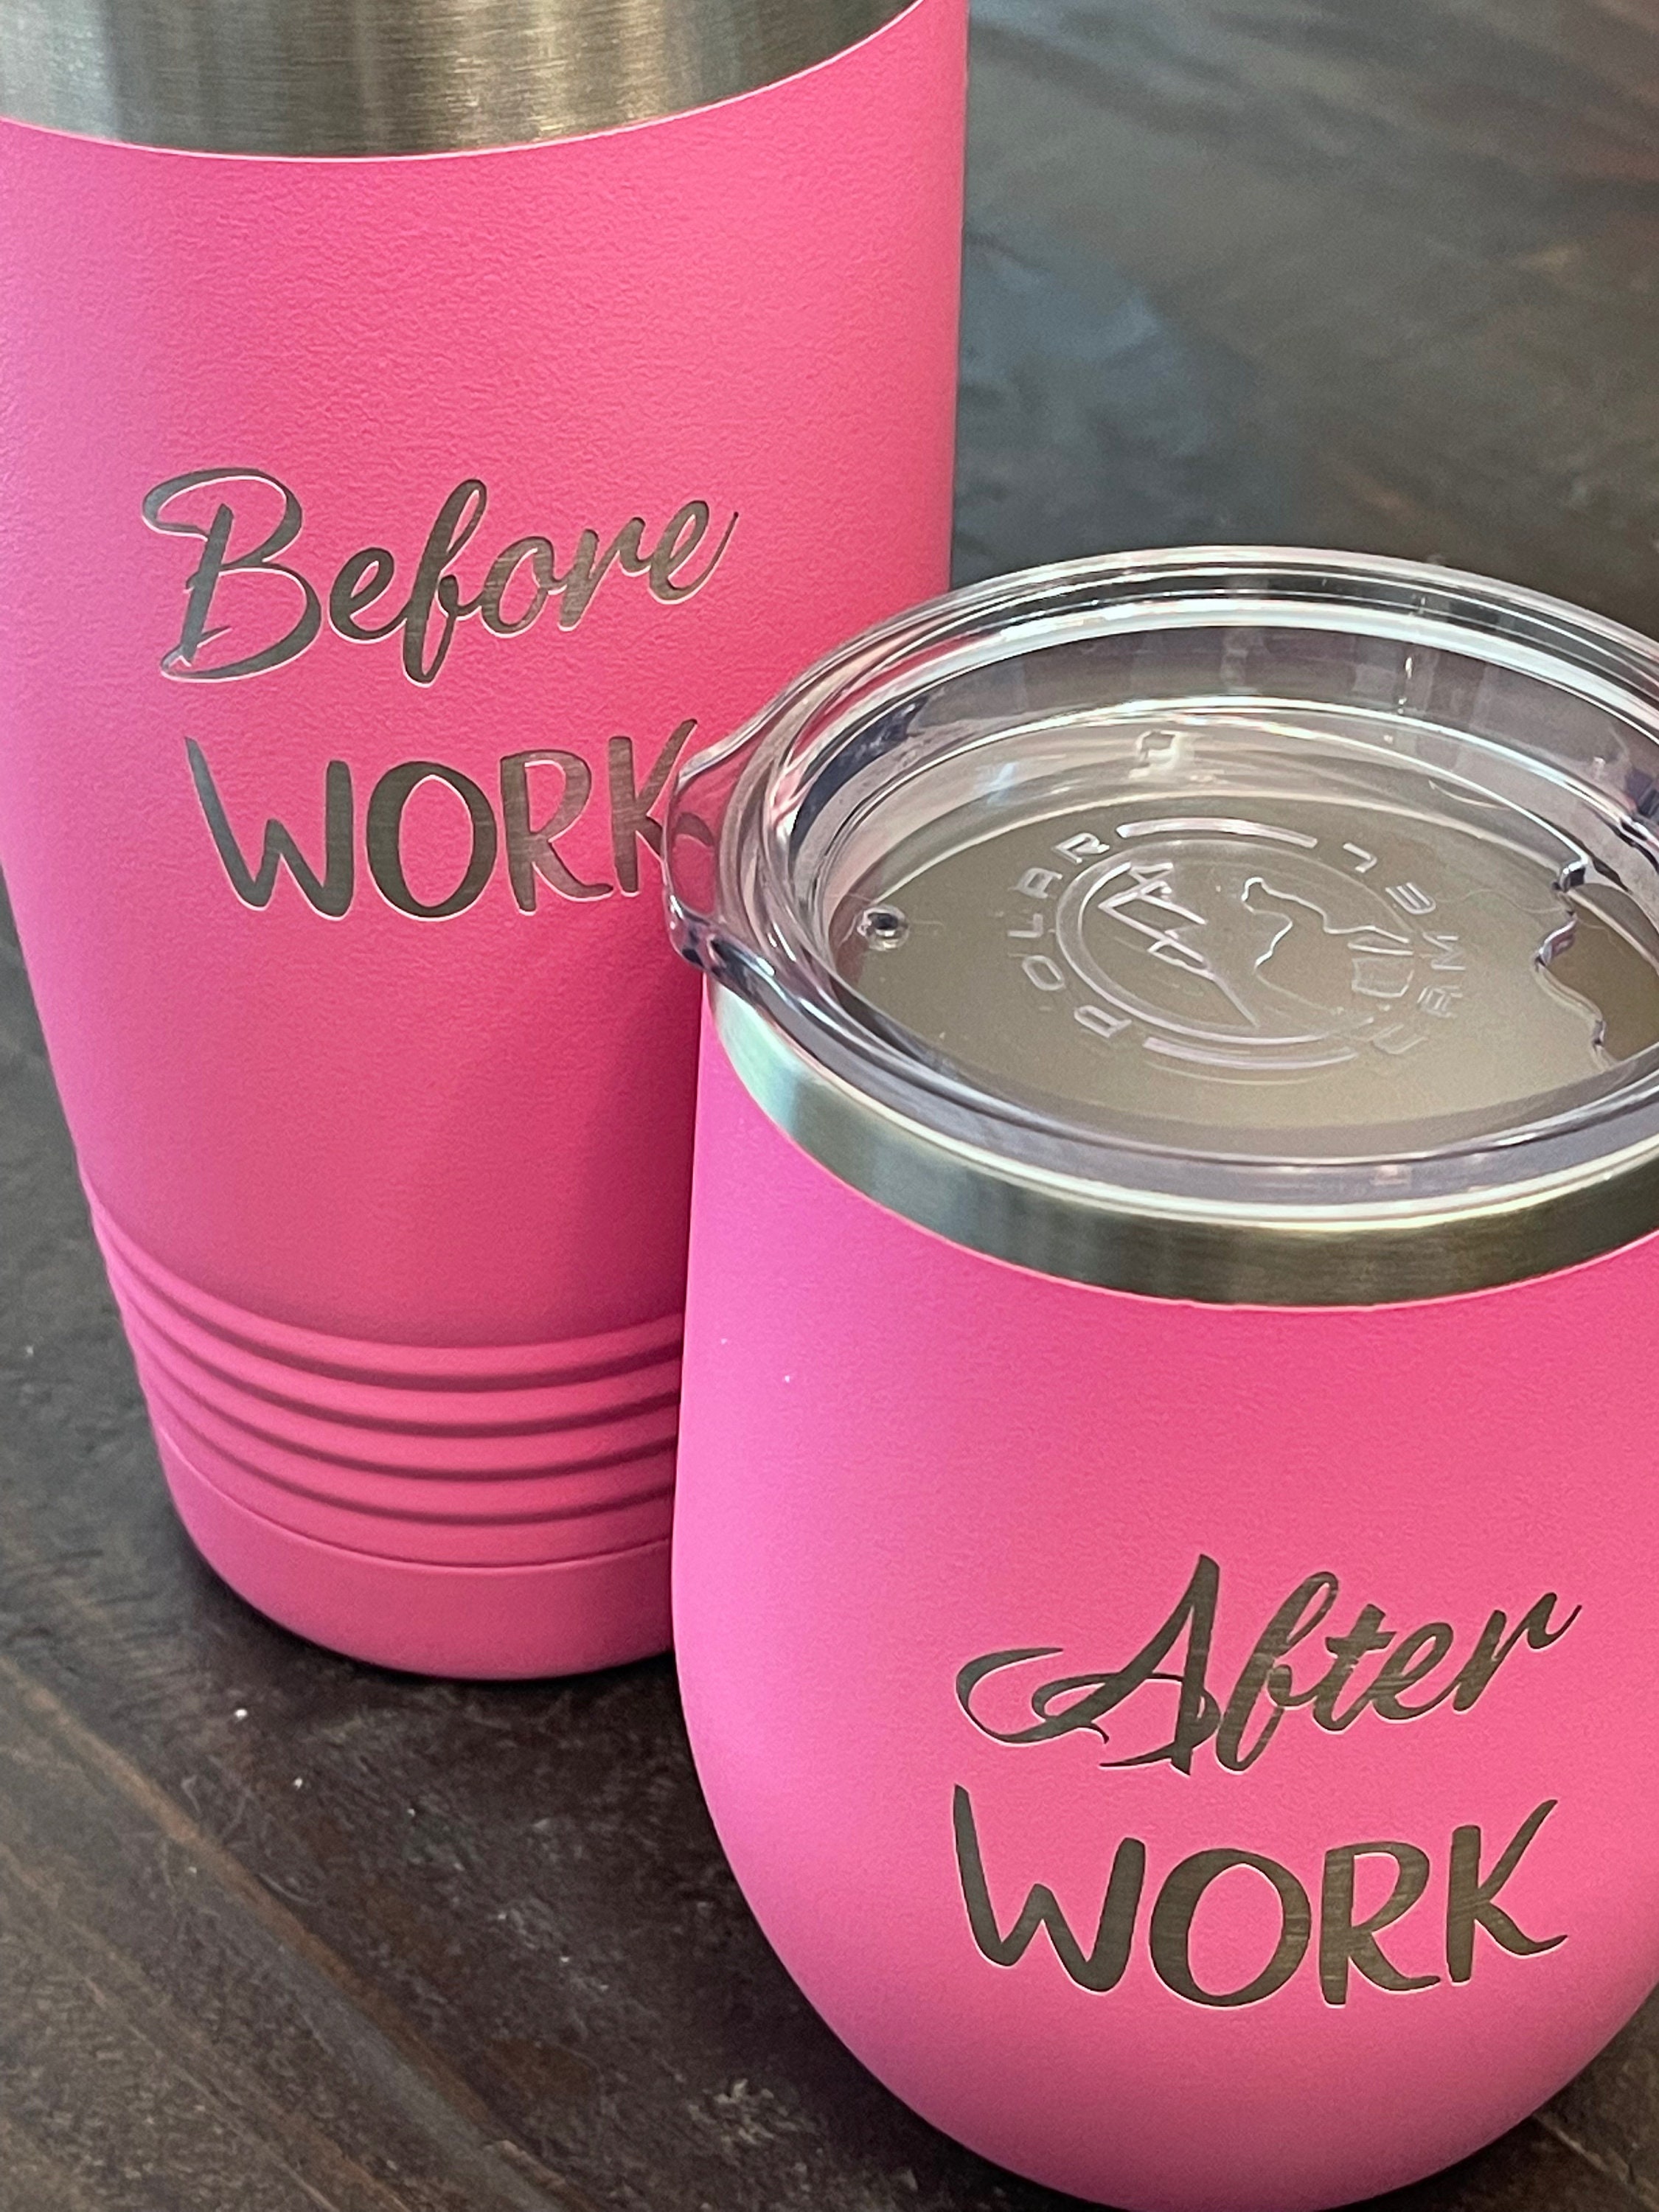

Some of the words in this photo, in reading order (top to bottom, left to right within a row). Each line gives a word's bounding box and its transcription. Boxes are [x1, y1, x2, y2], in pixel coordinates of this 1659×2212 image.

[142, 467, 739, 686] Before
[184, 718, 699, 920] WORK
[1007, 832, 1132, 1037] POLAR
[956, 1554, 1582, 1775] After
[952, 1784, 1568, 2008] WORK
